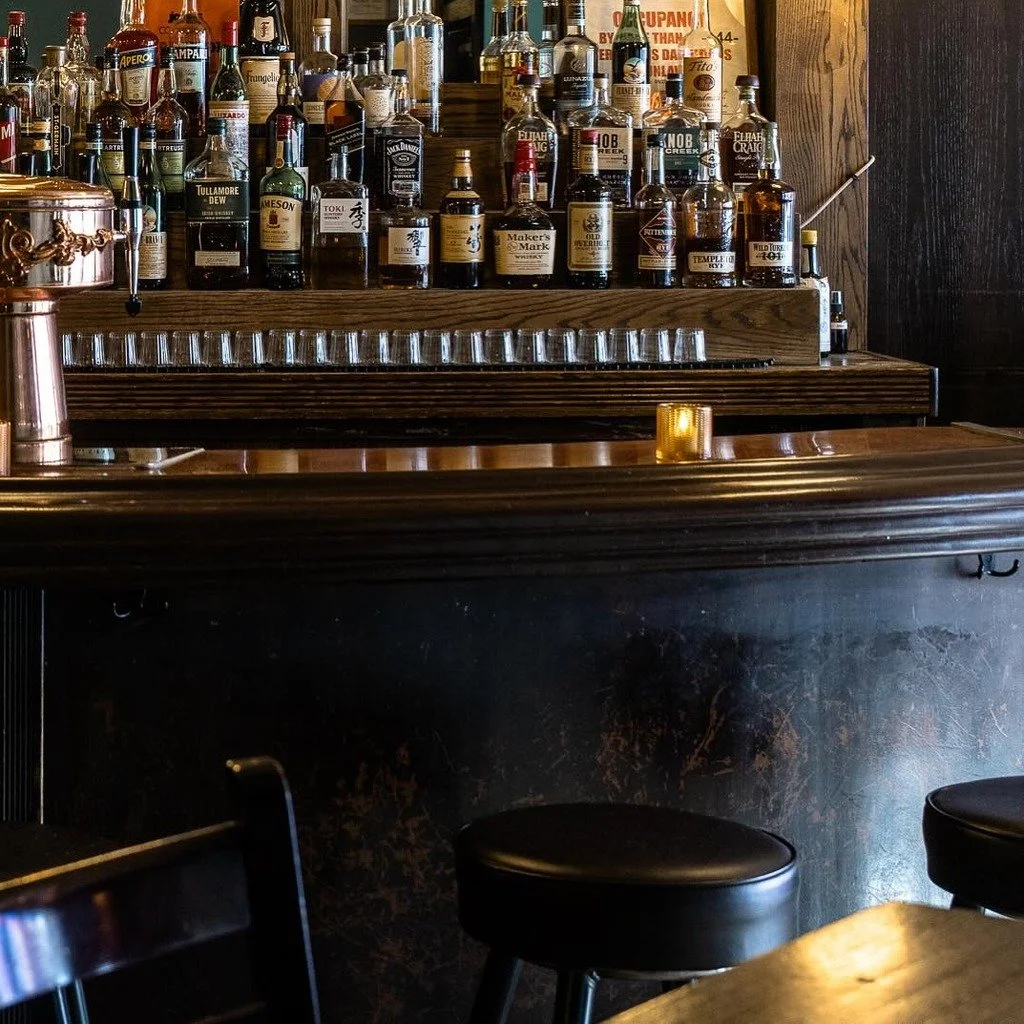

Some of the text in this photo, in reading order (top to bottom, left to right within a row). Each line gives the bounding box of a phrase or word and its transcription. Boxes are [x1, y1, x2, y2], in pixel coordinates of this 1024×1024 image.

[653, 33, 684, 44] THAN
[175, 48, 208, 59] AMPARI
[119, 53, 151, 68] APEROL
[196, 184, 240, 196] TULLAMORE
[208, 196, 227, 205] DEW
[323, 205, 345, 213] TOKI
[518, 242, 550, 251] Mark
